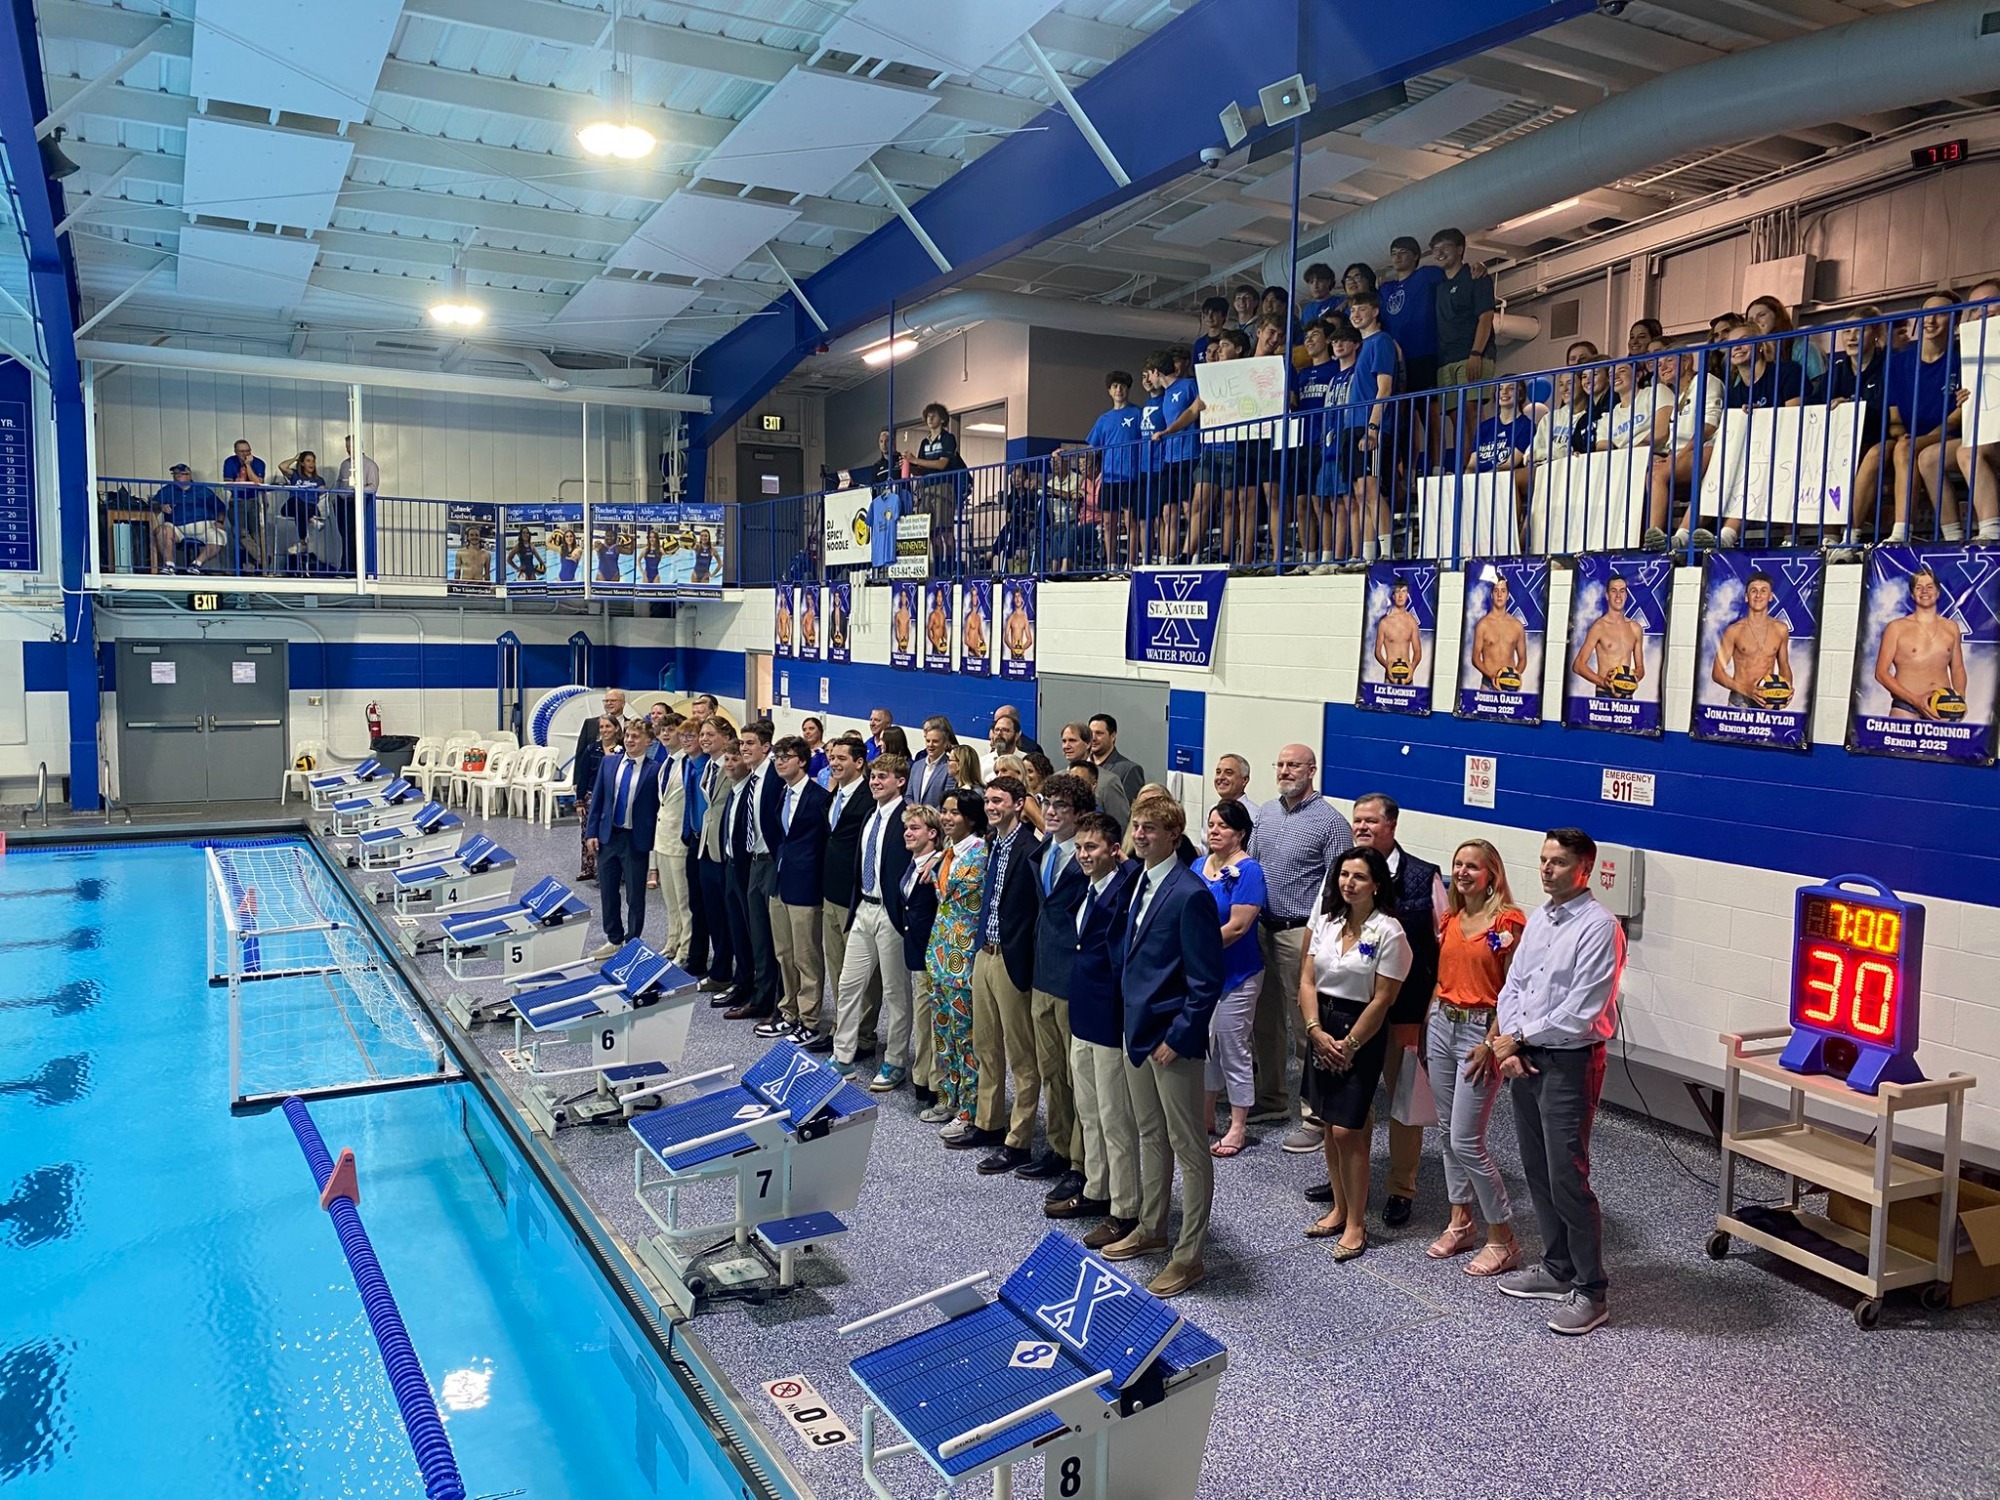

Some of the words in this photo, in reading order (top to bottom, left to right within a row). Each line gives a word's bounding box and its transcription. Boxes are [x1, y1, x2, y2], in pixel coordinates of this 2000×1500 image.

[1209, 375, 1242, 399] WE
[0, 419, 16, 428] YR.
[763, 415, 781, 430] EXIT
[451, 513, 476, 521] Ludwig
[827, 520, 834, 529] DJ
[827, 530, 843, 540] SPICY
[827, 540, 849, 551] NOODLE
[194, 594, 218, 610] EXIT
[1165, 602, 1204, 616] XAVIER
[1146, 648, 1177, 661] WATER
[1179, 650, 1206, 663] POLO
[1374, 685, 1386, 695] LEX
[1394, 698, 1408, 706] 2025
[1474, 692, 1499, 703] JOSHUA
[1500, 694, 1524, 705] GARZA
[1477, 704, 1497, 713] SENIOR
[1498, 706, 1514, 714] 2025
[1589, 699, 1610, 712] WILL
[1611, 701, 1640, 714] MORAN
[1589, 712, 1612, 723] SENIOR
[1613, 714, 1632, 724] 2025
[1705, 707, 1753, 723] JONATHAN
[1756, 711, 1795, 726] NAYLOR
[1719, 723, 1748, 734] SENIOR
[1749, 725, 1771, 736] 2025
[1866, 719, 1912, 734] CHARLIE
[1914, 722, 1971, 739] O'CONNOR
[1884, 736, 1917, 748] SENIOR
[1919, 739, 1948, 750] 2025
[1605, 770, 1652, 784] EMERGENCY
[1612, 780, 1632, 802] 911
[373, 815, 381, 826] 2
[406, 847, 413, 860] 3
[448, 888, 457, 903] 4
[1831, 902, 1899, 952] 7:00
[512, 946, 523, 964] 5
[1805, 950, 1894, 1034] 30
[601, 1029, 615, 1051] 6
[760, 1052, 820, 1105] X
[756, 1169, 773, 1199] 7
[1036, 1256, 1132, 1349] X
[1016, 1344, 1053, 1364] 8
[785, 1403, 800, 1413] IN
[1059, 1456, 1081, 1498] 8
